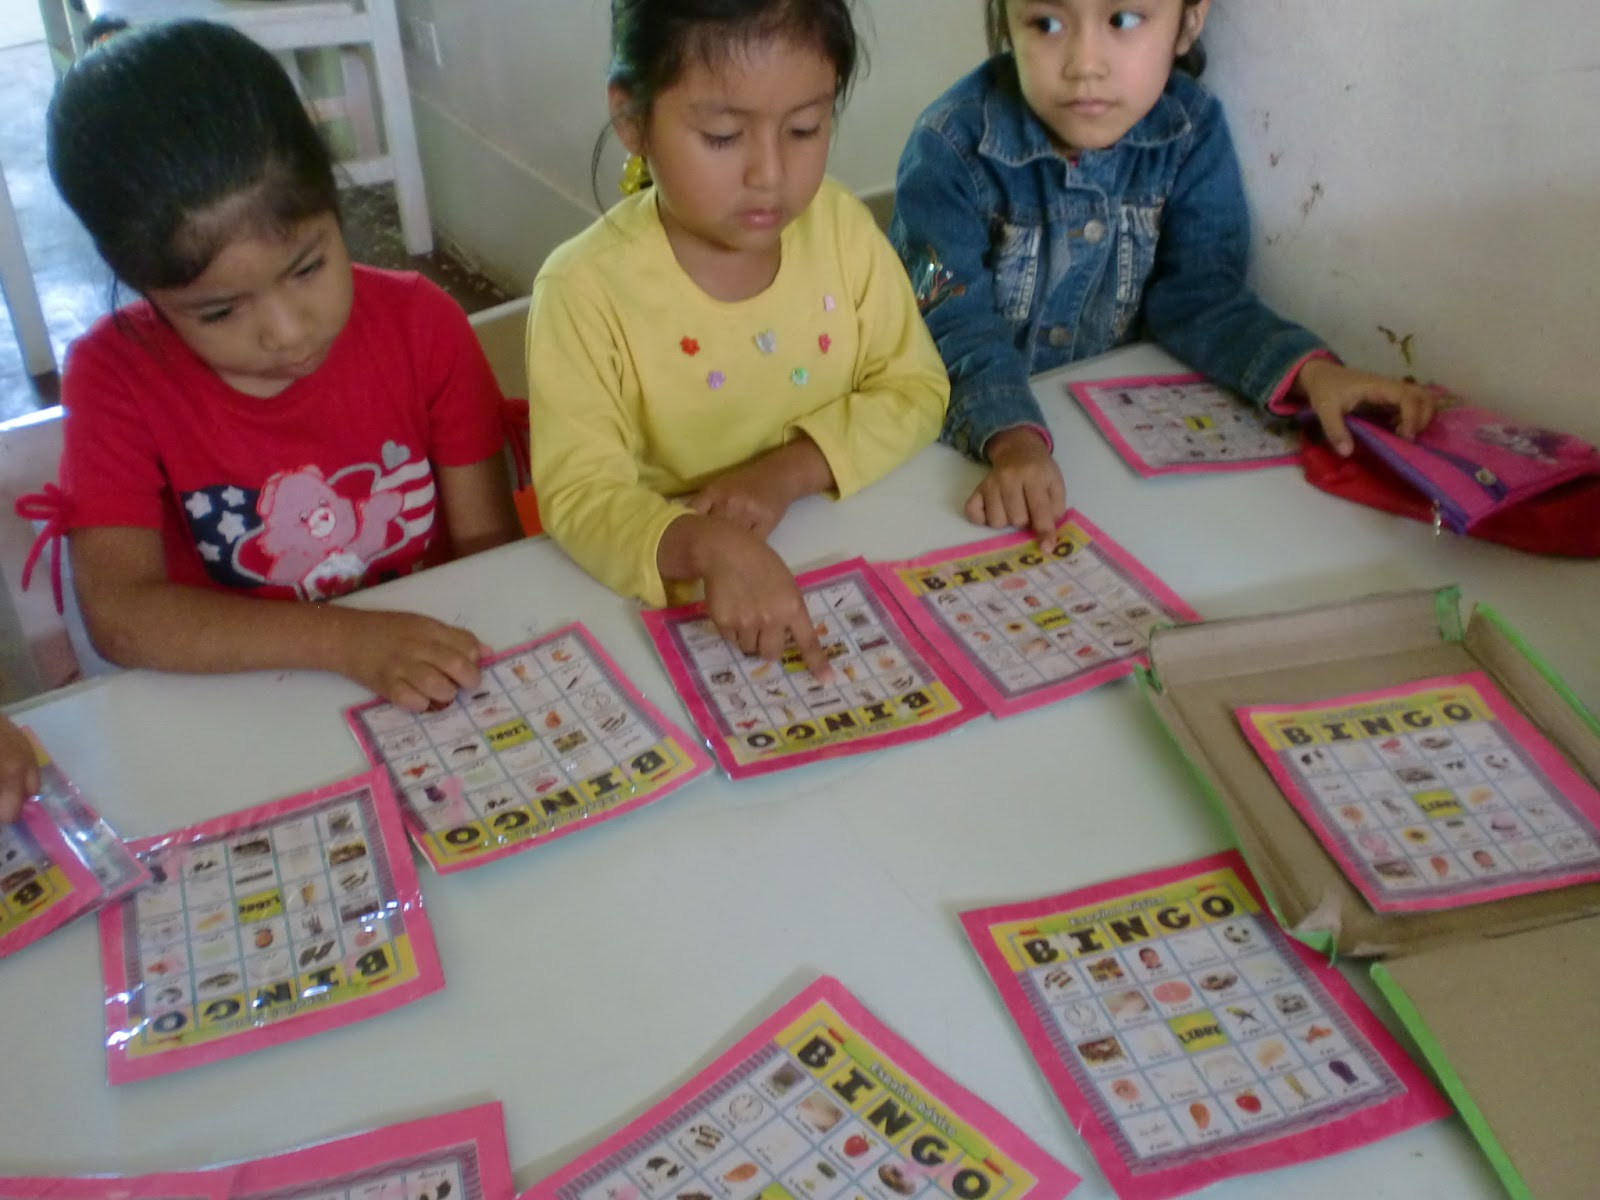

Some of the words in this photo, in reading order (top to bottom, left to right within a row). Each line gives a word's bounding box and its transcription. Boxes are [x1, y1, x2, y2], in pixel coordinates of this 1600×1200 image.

[923, 541, 1075, 590] BINGO
[747, 688, 930, 748] BINGO
[1281, 703, 1472, 747] BINGO
[445, 750, 666, 844] BINGO
[1023, 895, 1235, 964] BINGO
[153, 948, 389, 1033] BINGO
[1178, 1022, 1222, 1045] LIBRE
[797, 1035, 991, 1199] BINGO
